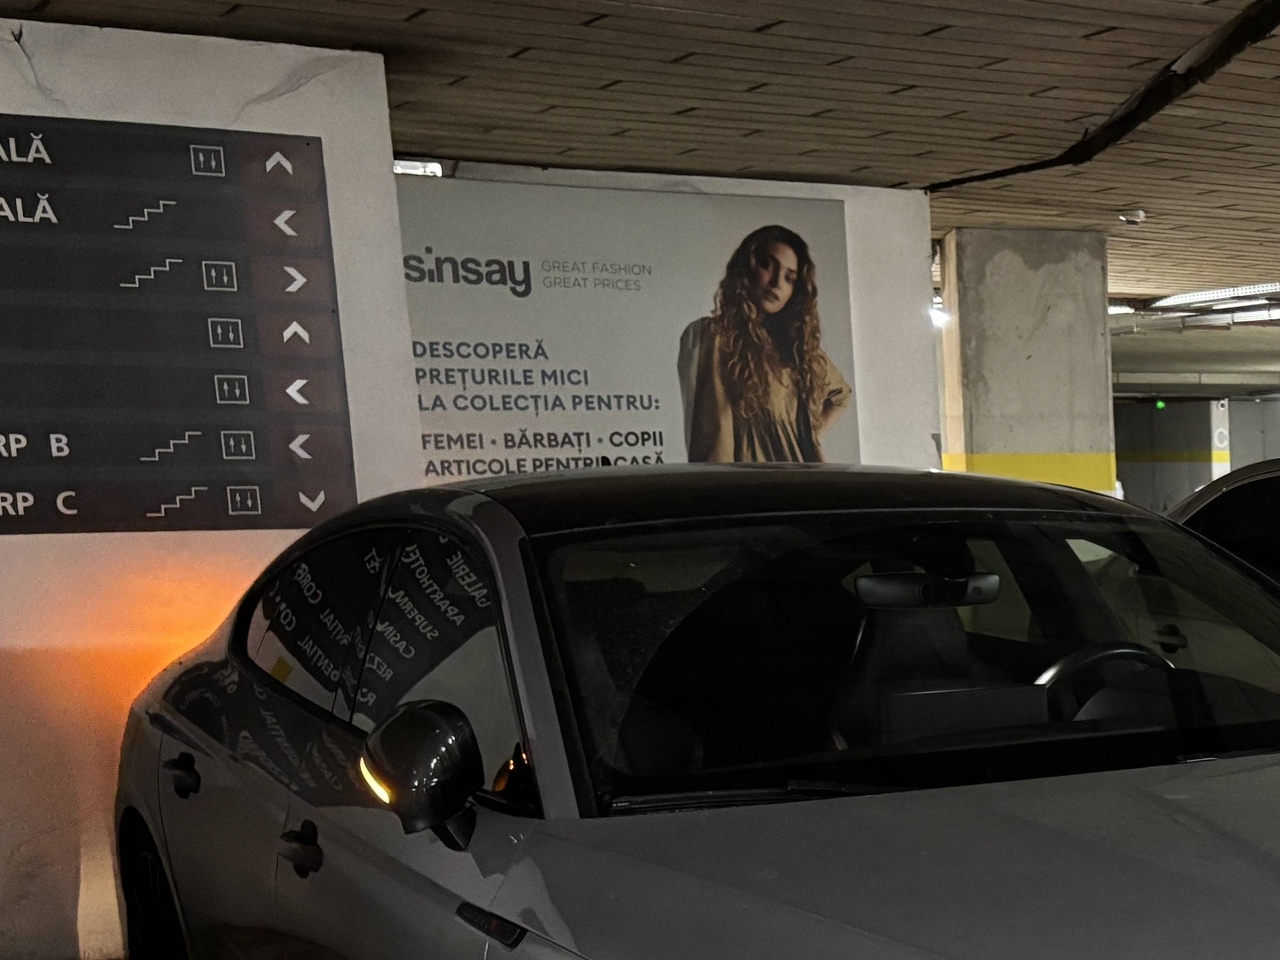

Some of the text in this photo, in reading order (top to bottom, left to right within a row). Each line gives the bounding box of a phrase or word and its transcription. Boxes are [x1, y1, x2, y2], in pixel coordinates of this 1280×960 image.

[403, 246, 532, 297] sinsay
[541, 260, 652, 276] GREAT FASHION
[543, 277, 641, 291] GREAT PRICES
[412, 339, 549, 360] DESCOPERĂ
[415, 368, 589, 391] PREȚURILE MICI
[417, 394, 660, 417] LA COLECȚIA PENTRU:
[49, 433, 70, 458] B
[421, 429, 664, 454] FEMEI BĂRBAȚI COPII
[424, 458, 528, 477] ARTICOLE
[56, 491, 78, 515] C
